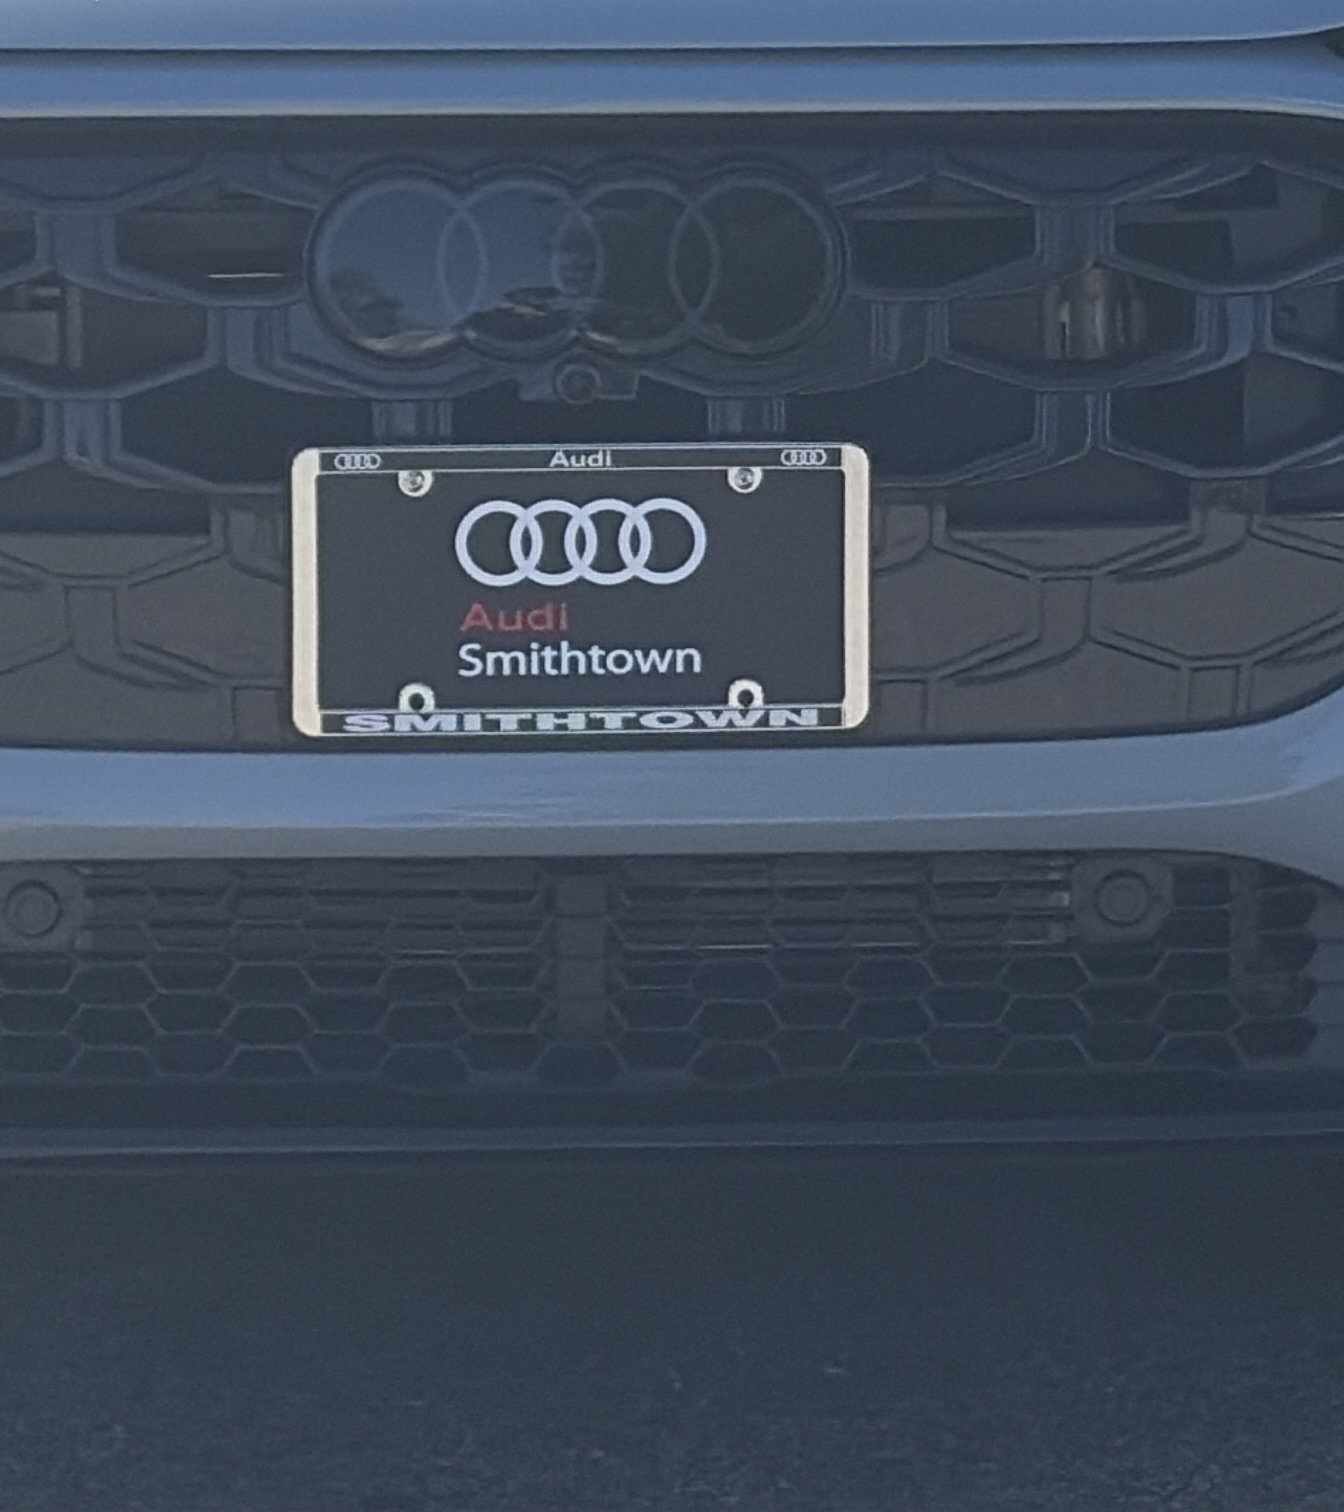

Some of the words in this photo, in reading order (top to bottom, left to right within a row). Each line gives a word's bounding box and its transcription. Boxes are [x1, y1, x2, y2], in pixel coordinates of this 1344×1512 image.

[549, 449, 613, 468] Audi
[460, 602, 570, 633] Audi
[458, 640, 702, 679] Smithtown
[342, 708, 820, 734] SMITHTOWN
